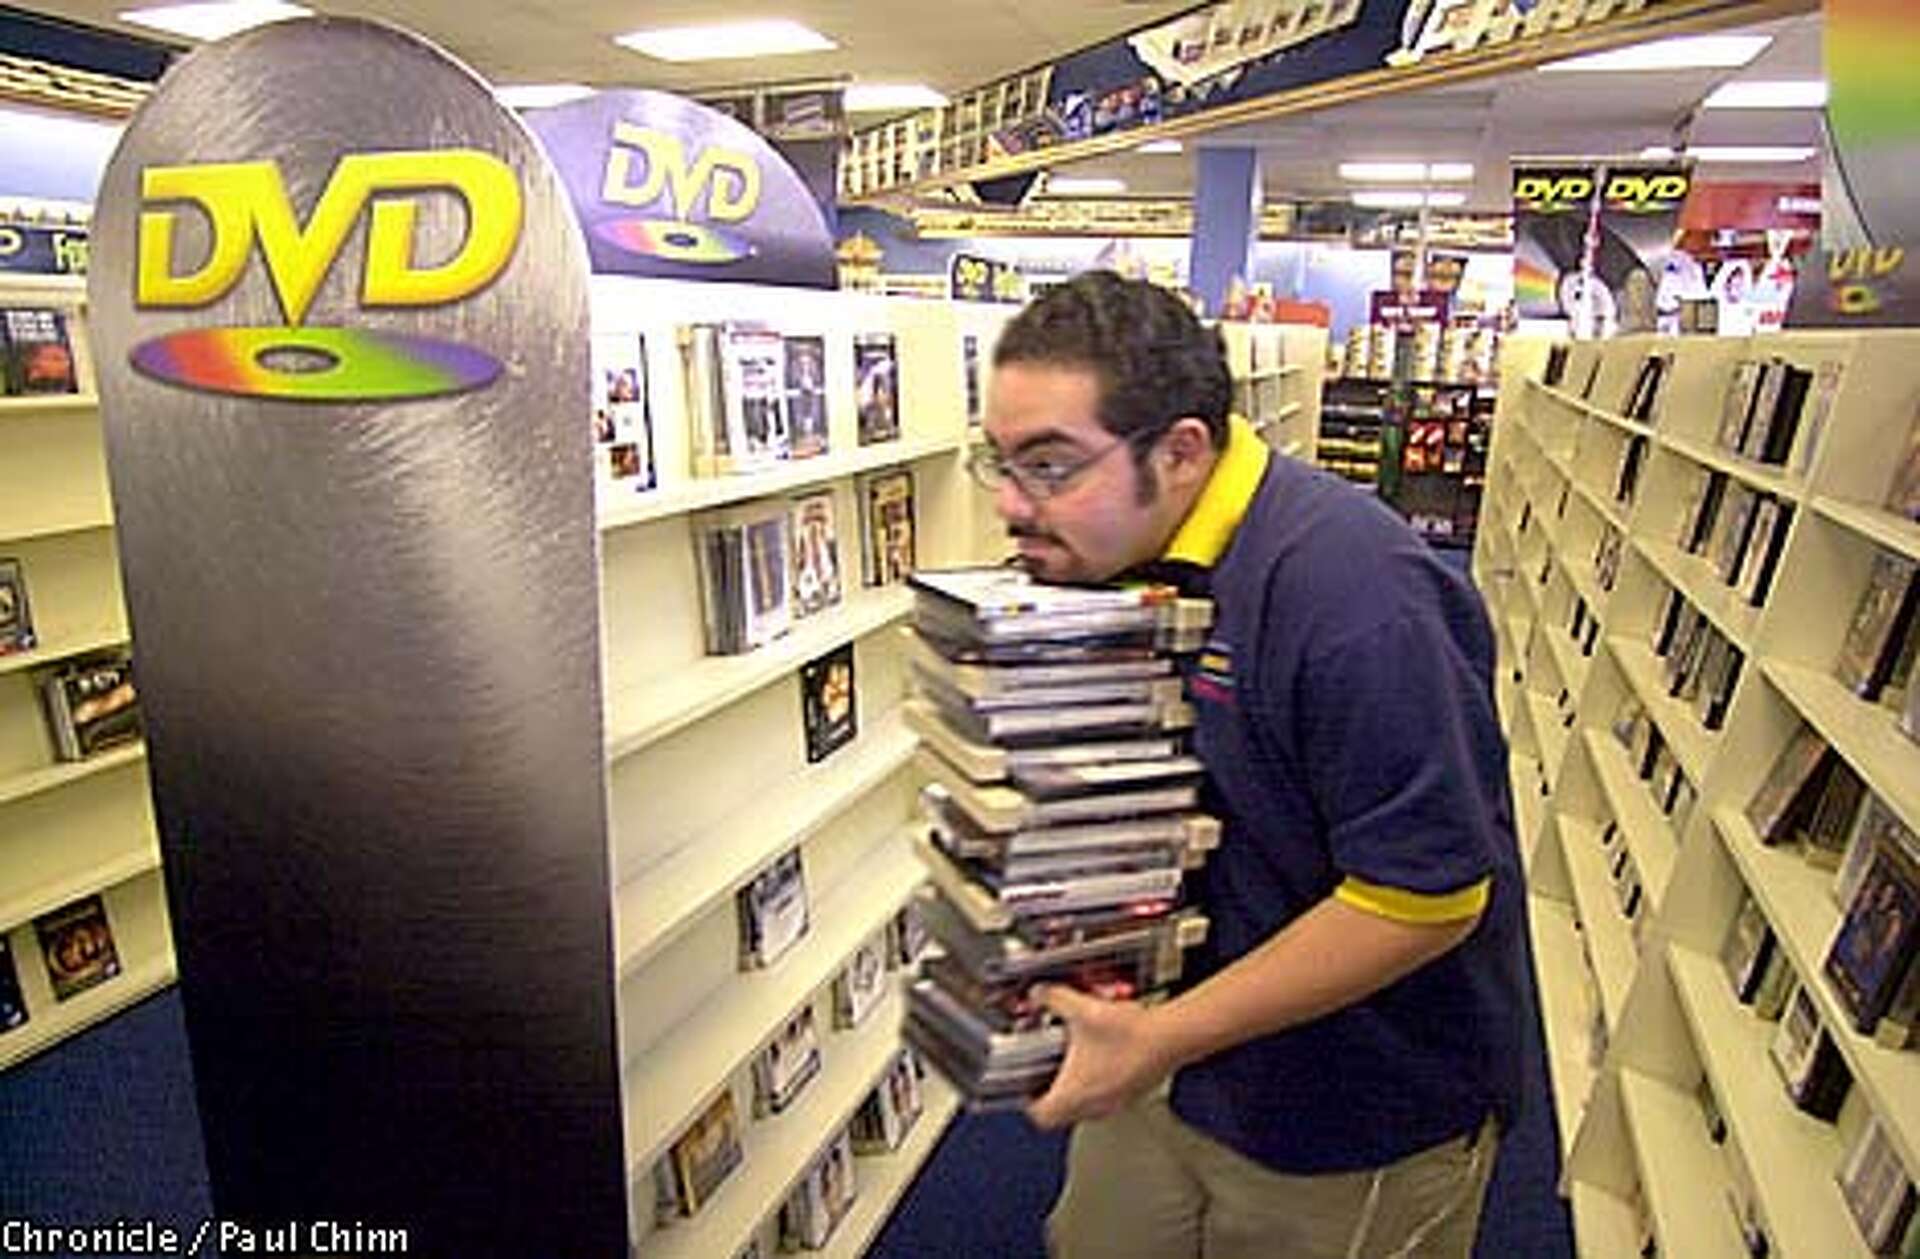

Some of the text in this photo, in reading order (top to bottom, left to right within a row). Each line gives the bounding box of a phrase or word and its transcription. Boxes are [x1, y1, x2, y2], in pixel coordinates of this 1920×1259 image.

[602, 120, 763, 222] DVD
[1514, 177, 1593, 203] DVD
[1604, 175, 1688, 203] DVD
[136, 147, 524, 328] DVD
